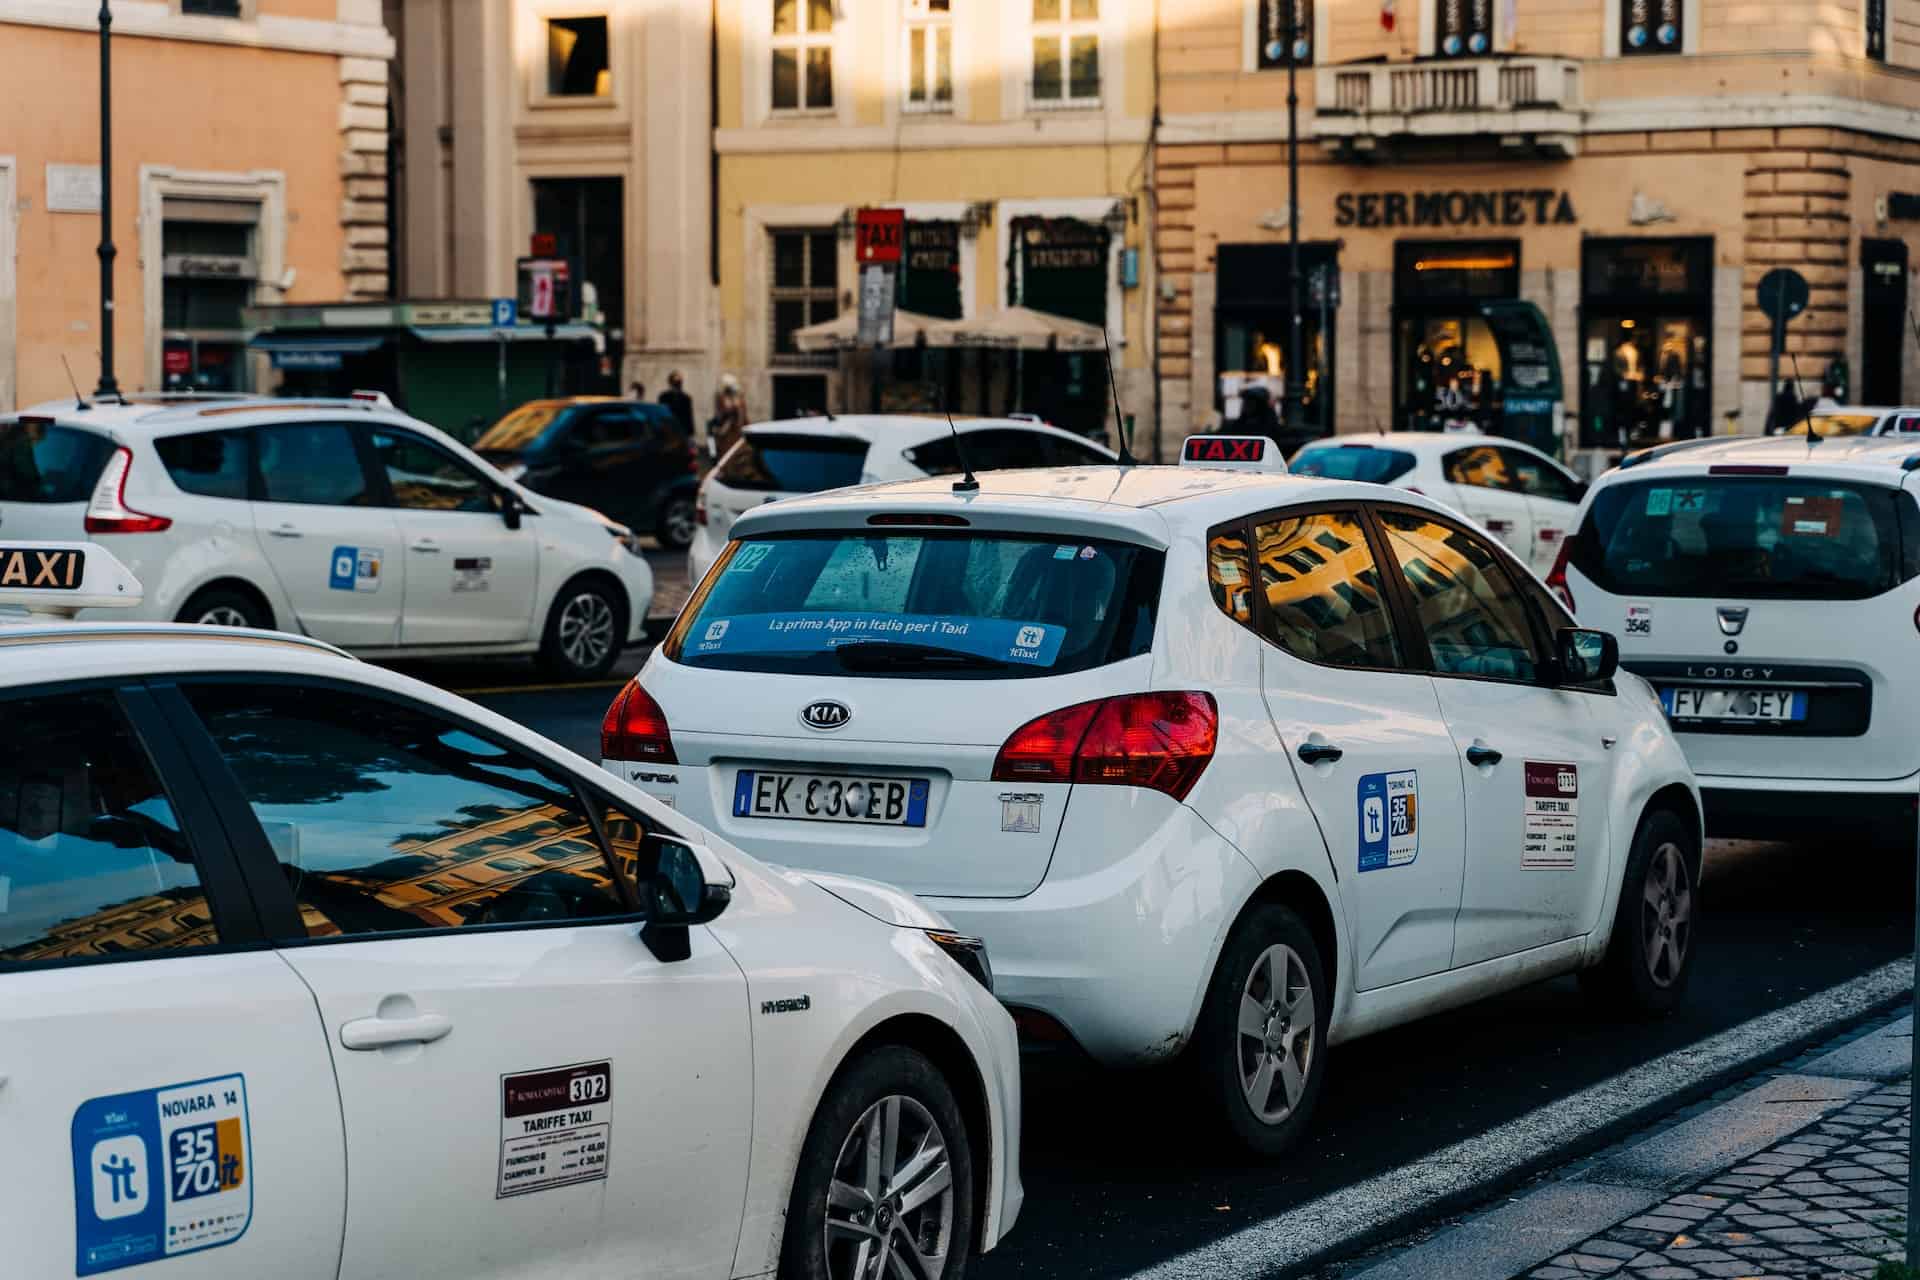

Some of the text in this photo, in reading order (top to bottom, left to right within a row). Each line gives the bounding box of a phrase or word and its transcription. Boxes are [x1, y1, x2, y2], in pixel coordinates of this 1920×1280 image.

[1335, 189, 1577, 228] SERMONETA
[859, 222, 902, 246] TAXI
[1189, 440, 1261, 460] TAXI
[0, 551, 77, 586] AXI
[768, 619, 783, 631] La
[784, 618, 824, 633] prima
[823, 618, 851, 633] App
[854, 619, 867, 630] in
[869, 619, 903, 632] Italia
[904, 622, 931, 634] per
[940, 622, 969, 635] Taxi
[1626, 618, 1650, 633] 3546
[1688, 666, 1774, 680] LODGY
[810, 706, 841, 721] KIA
[1391, 798, 1407, 818] 35
[1557, 801, 1570, 812] TAXI
[761, 995, 810, 1014] HYBRID
[573, 1076, 604, 1101] 302
[162, 1091, 238, 1118] NOVARA 14
[523, 1110, 593, 1133] TARIFFE TAXI
[175, 1127, 215, 1166] 35
[100, 1154, 139, 1203] it
